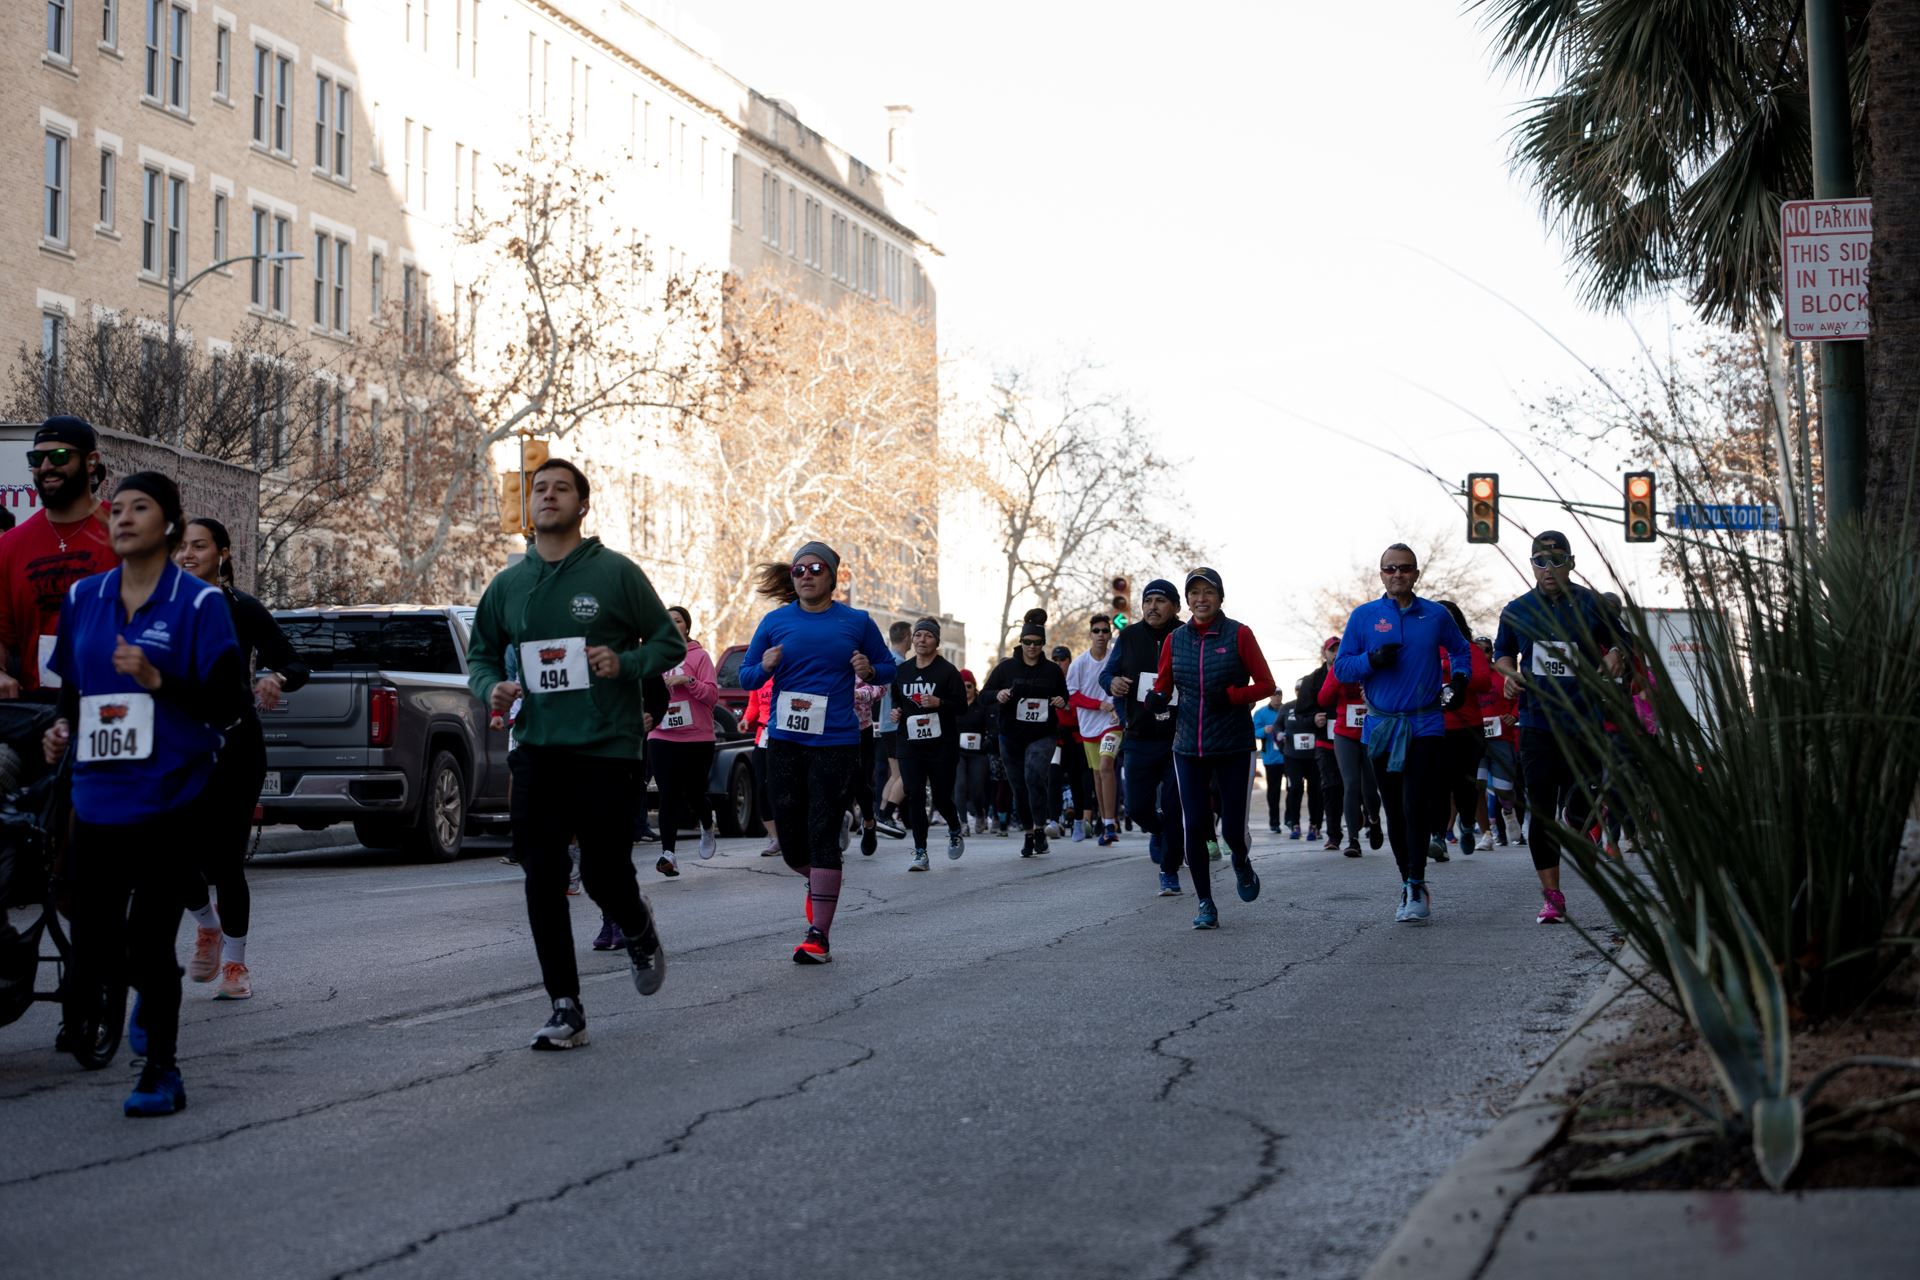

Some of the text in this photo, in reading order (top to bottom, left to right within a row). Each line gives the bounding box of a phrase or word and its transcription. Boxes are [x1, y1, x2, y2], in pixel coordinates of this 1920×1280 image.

[1785, 206, 1873, 234] NO PARKIN
[1790, 242, 1872, 263] THIS SID
[1796, 269, 1816, 289] IN
[1801, 293, 1869, 314] BLOCK
[1793, 323, 1814, 332] TOW
[1819, 321, 1848, 331] AWAY
[540, 669, 569, 690] 494
[902, 682, 937, 697] UIW
[668, 716, 683, 727] 450
[786, 715, 810, 731] 430
[1025, 711, 1039, 721] 247
[917, 728, 932, 738] 244
[89, 728, 137, 758] 1064
